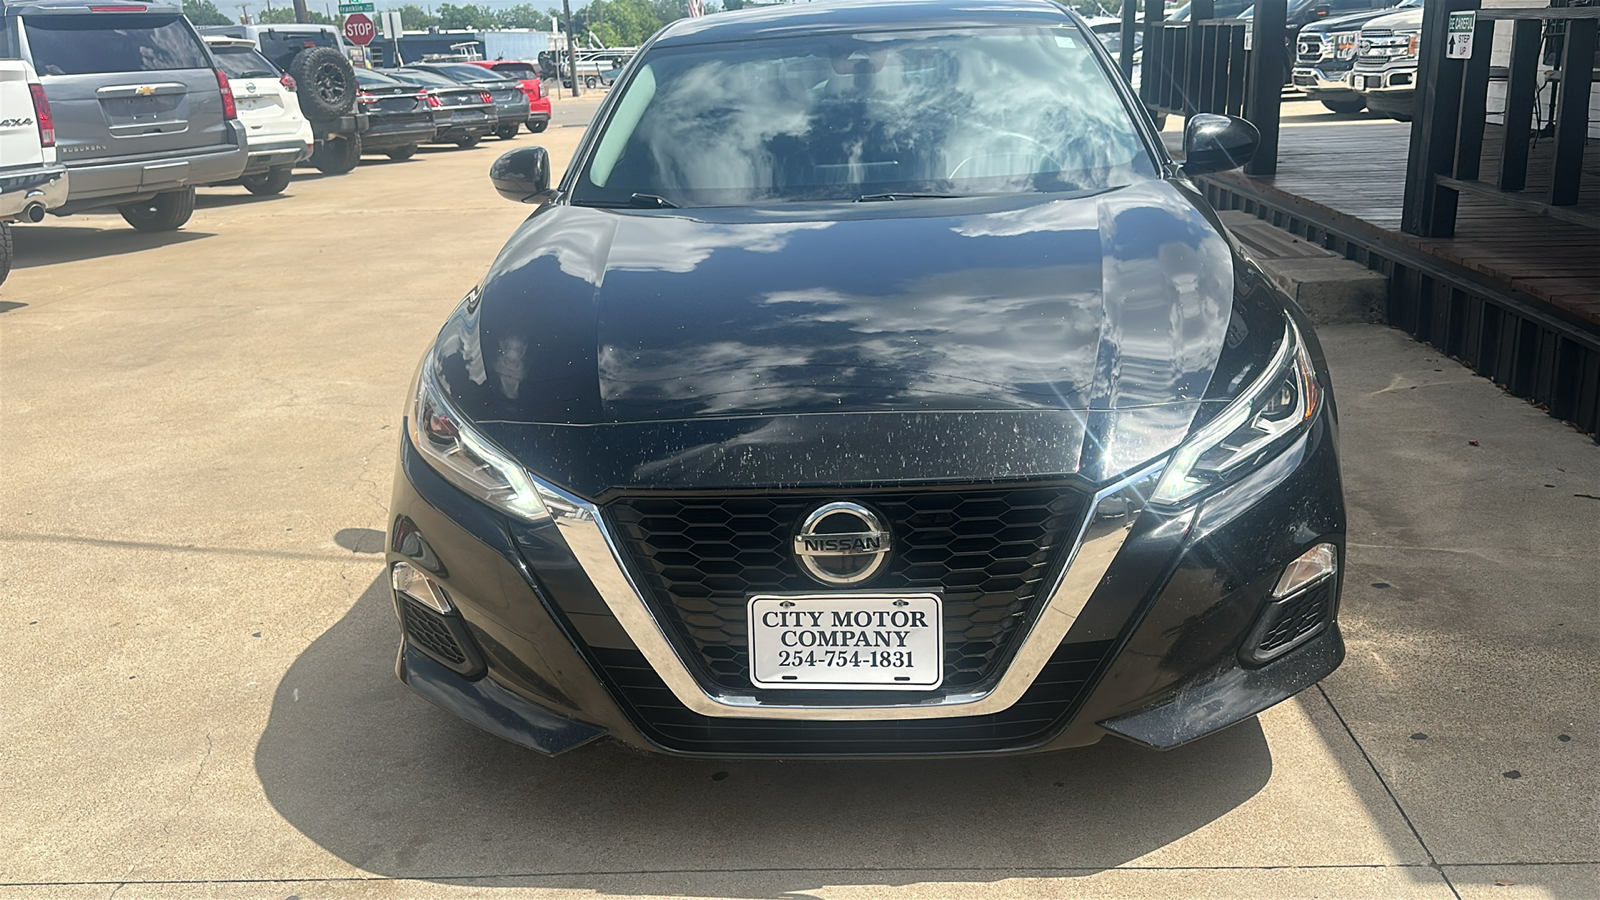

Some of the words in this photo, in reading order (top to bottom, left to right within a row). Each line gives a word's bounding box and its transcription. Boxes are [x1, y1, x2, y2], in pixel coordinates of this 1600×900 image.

[346, 22, 372, 36] STOP
[1450, 18, 1455, 30] BE
[1456, 18, 1473, 30] CAREFUL
[1458, 34, 1470, 44] STEP
[1460, 46, 1466, 56] UP
[62, 145, 107, 153] SUBURBAN
[804, 536, 881, 552] NISSAN
[762, 611, 824, 628] CITY
[831, 611, 929, 628] MOTOR
[780, 630, 911, 648] COMPANY
[778, 650, 915, 668] 254-754-1831
